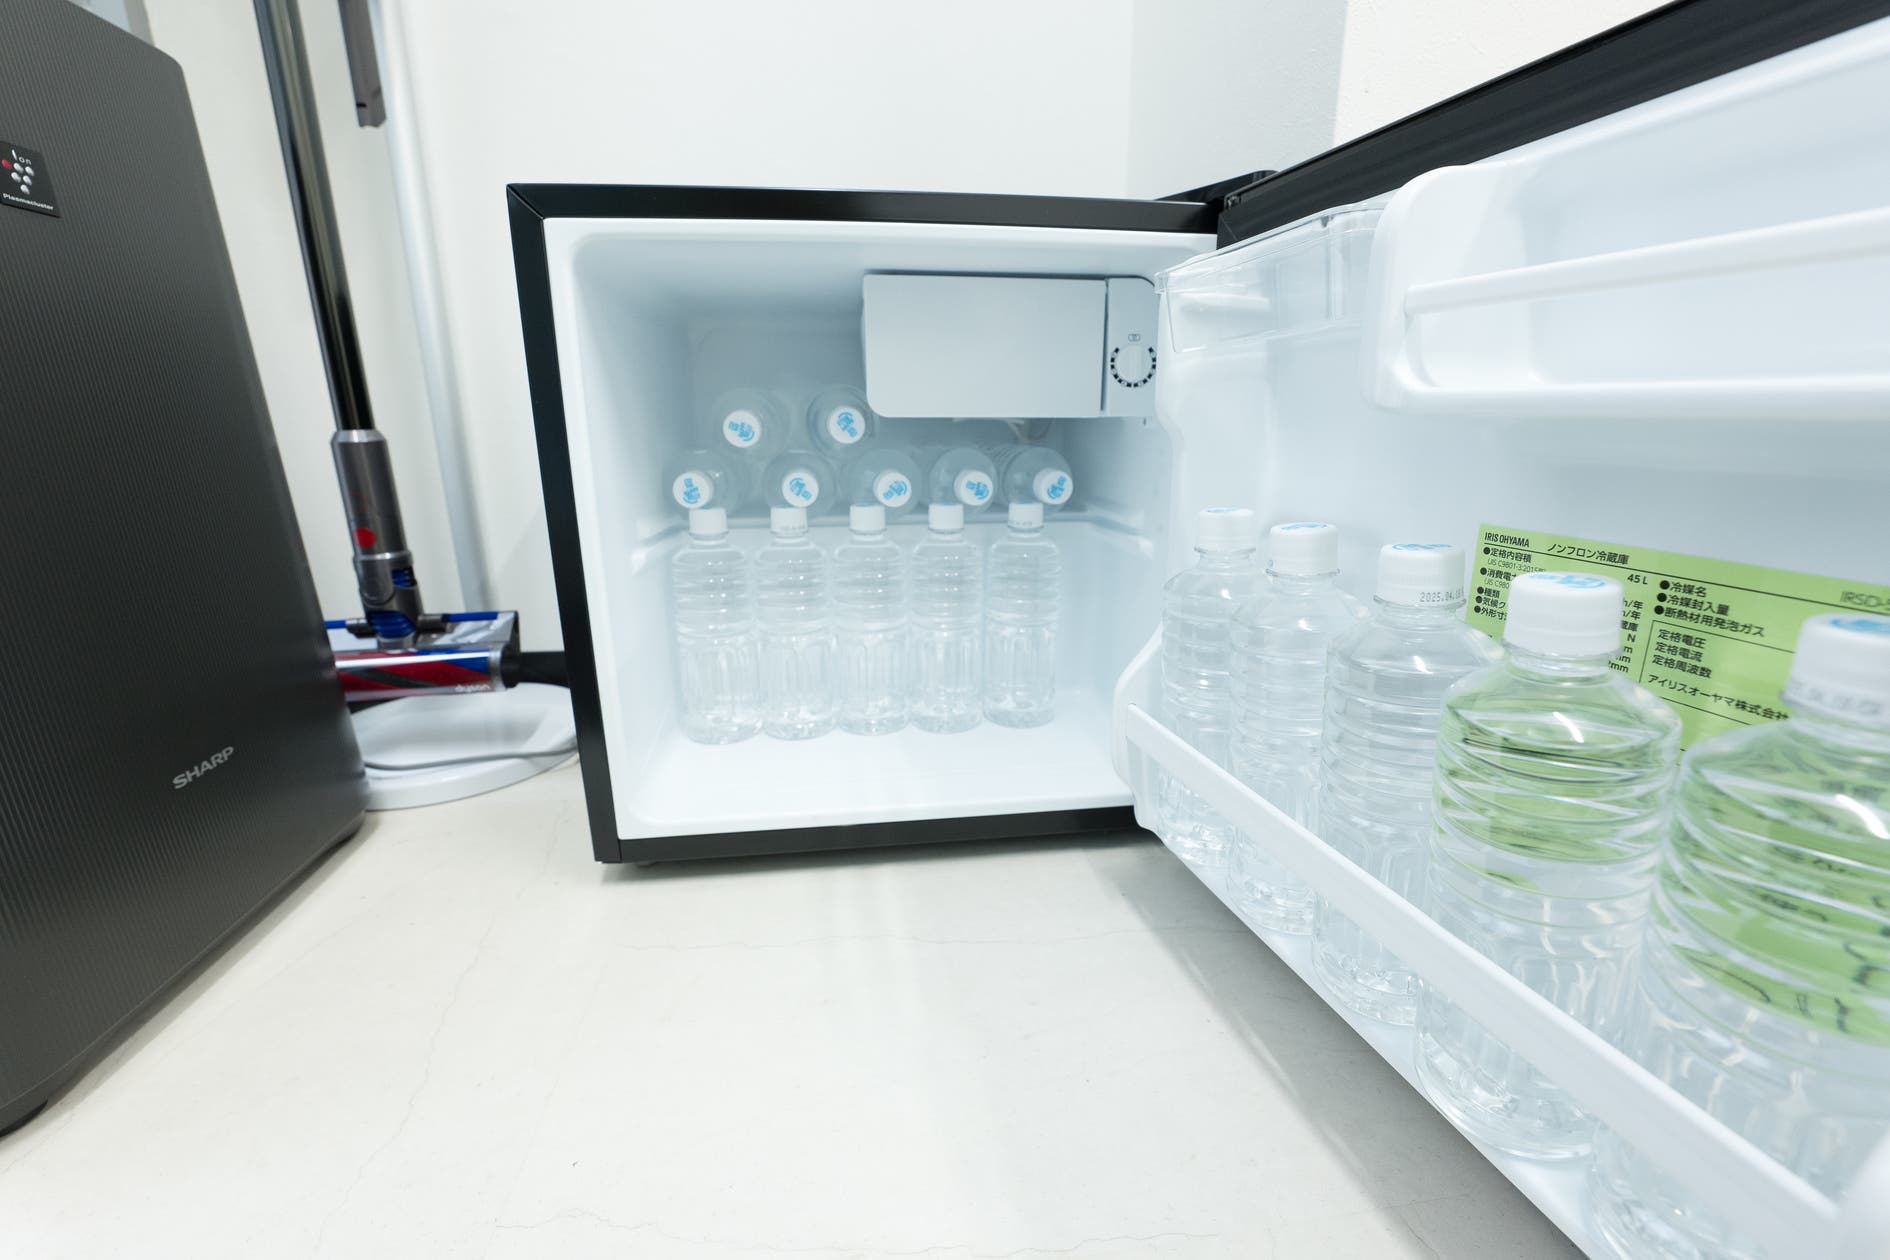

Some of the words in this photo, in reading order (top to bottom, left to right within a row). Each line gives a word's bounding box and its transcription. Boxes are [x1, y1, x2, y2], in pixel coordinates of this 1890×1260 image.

[2, 193, 54, 211] Plasmacluster
[1484, 532, 1499, 543] IRIS
[1499, 535, 1530, 548] OHYAMA
[1490, 547, 1532, 563] 定格内容積
[1547, 543, 1629, 565] ノンフロン冷蔵庫
[1627, 573, 1641, 584] 45
[1643, 576, 1648, 585] L
[1484, 587, 1501, 599] 種類
[1669, 580, 1707, 598] 冷媒名
[1666, 593, 1730, 616] 冷媒封入量
[1663, 606, 1765, 638] 断熱材用発泡ガス
[1627, 633, 1636, 643] N
[1657, 628, 1707, 649] 定格電圧
[1654, 641, 1704, 662] 定格電流
[1651, 654, 1713, 679] 定格周波数
[172, 746, 234, 789] SHARP
